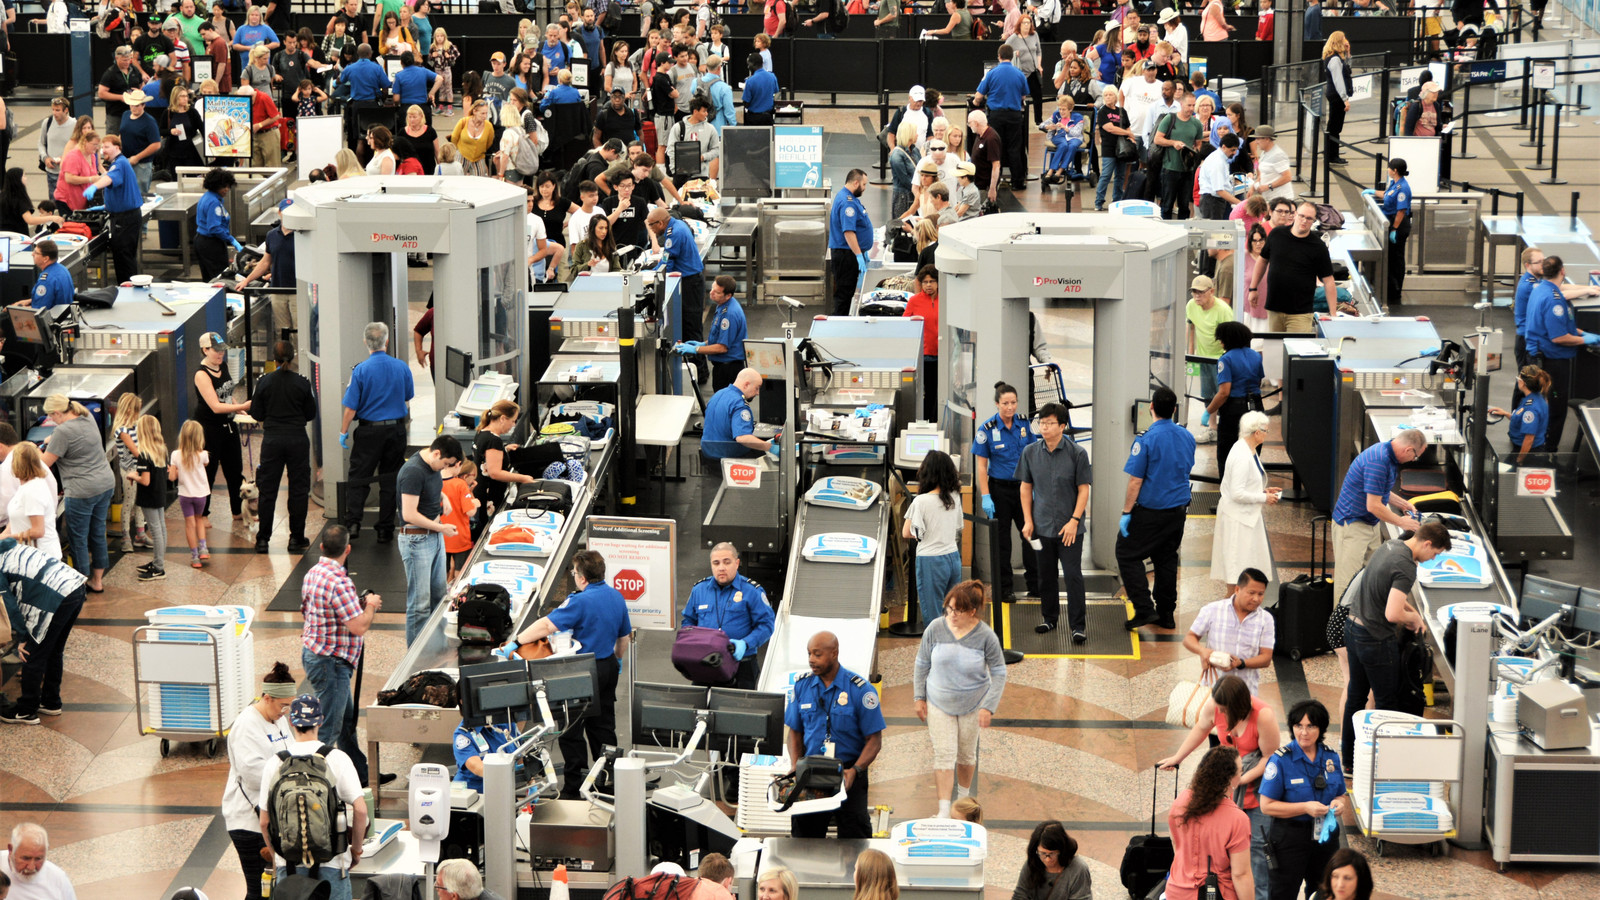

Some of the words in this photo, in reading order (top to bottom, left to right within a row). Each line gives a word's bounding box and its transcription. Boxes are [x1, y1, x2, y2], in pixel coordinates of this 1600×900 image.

[624, 276, 628, 285] 5
[786, 330, 791, 339] 6
[1482, 335, 1487, 344] 7
[1528, 478, 1549, 486] STOP
[615, 579, 644, 591] STOP
